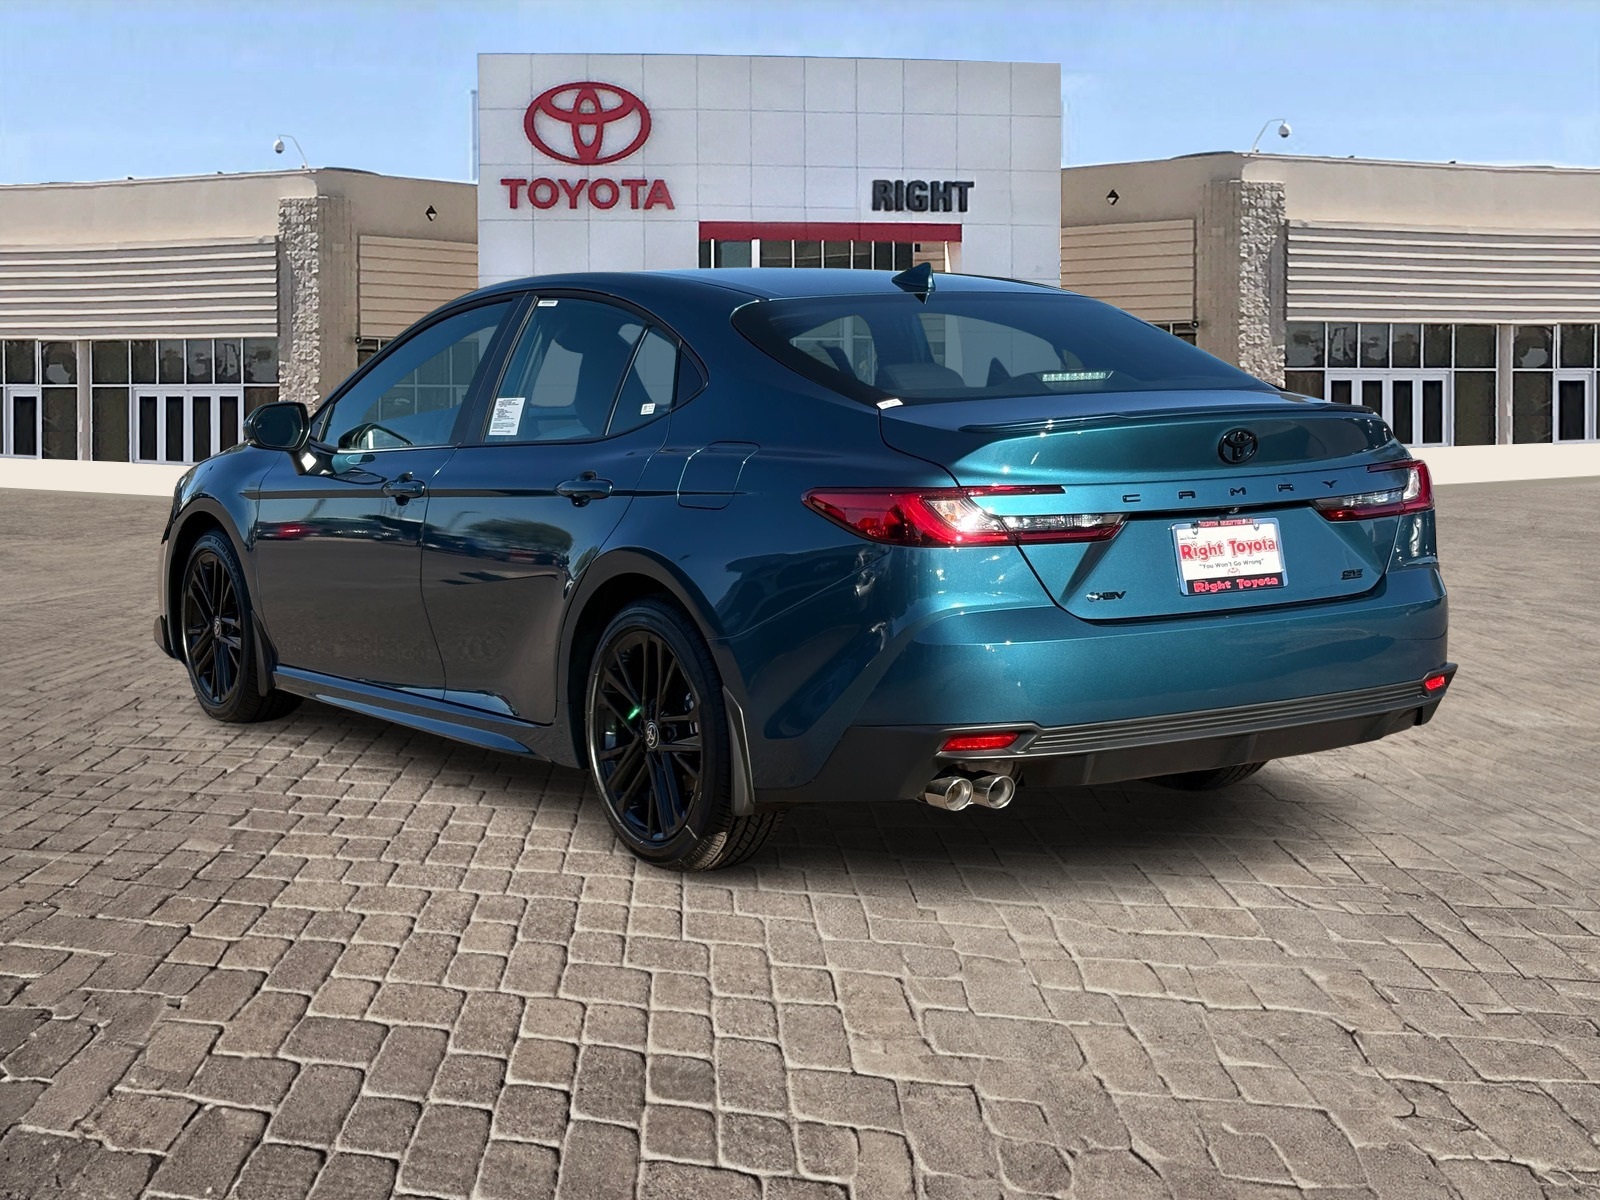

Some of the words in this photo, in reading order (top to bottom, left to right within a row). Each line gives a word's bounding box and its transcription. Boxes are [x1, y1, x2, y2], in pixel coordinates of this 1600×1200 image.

[500, 178, 675, 209] TOYOTA
[872, 179, 975, 212] RIGHT
[1122, 479, 1339, 504] CAMRY
[1180, 542, 1224, 561] Right
[1228, 537, 1277, 557] Toyota
[1193, 580, 1232, 593] Right
[1236, 577, 1279, 590] Toyota
